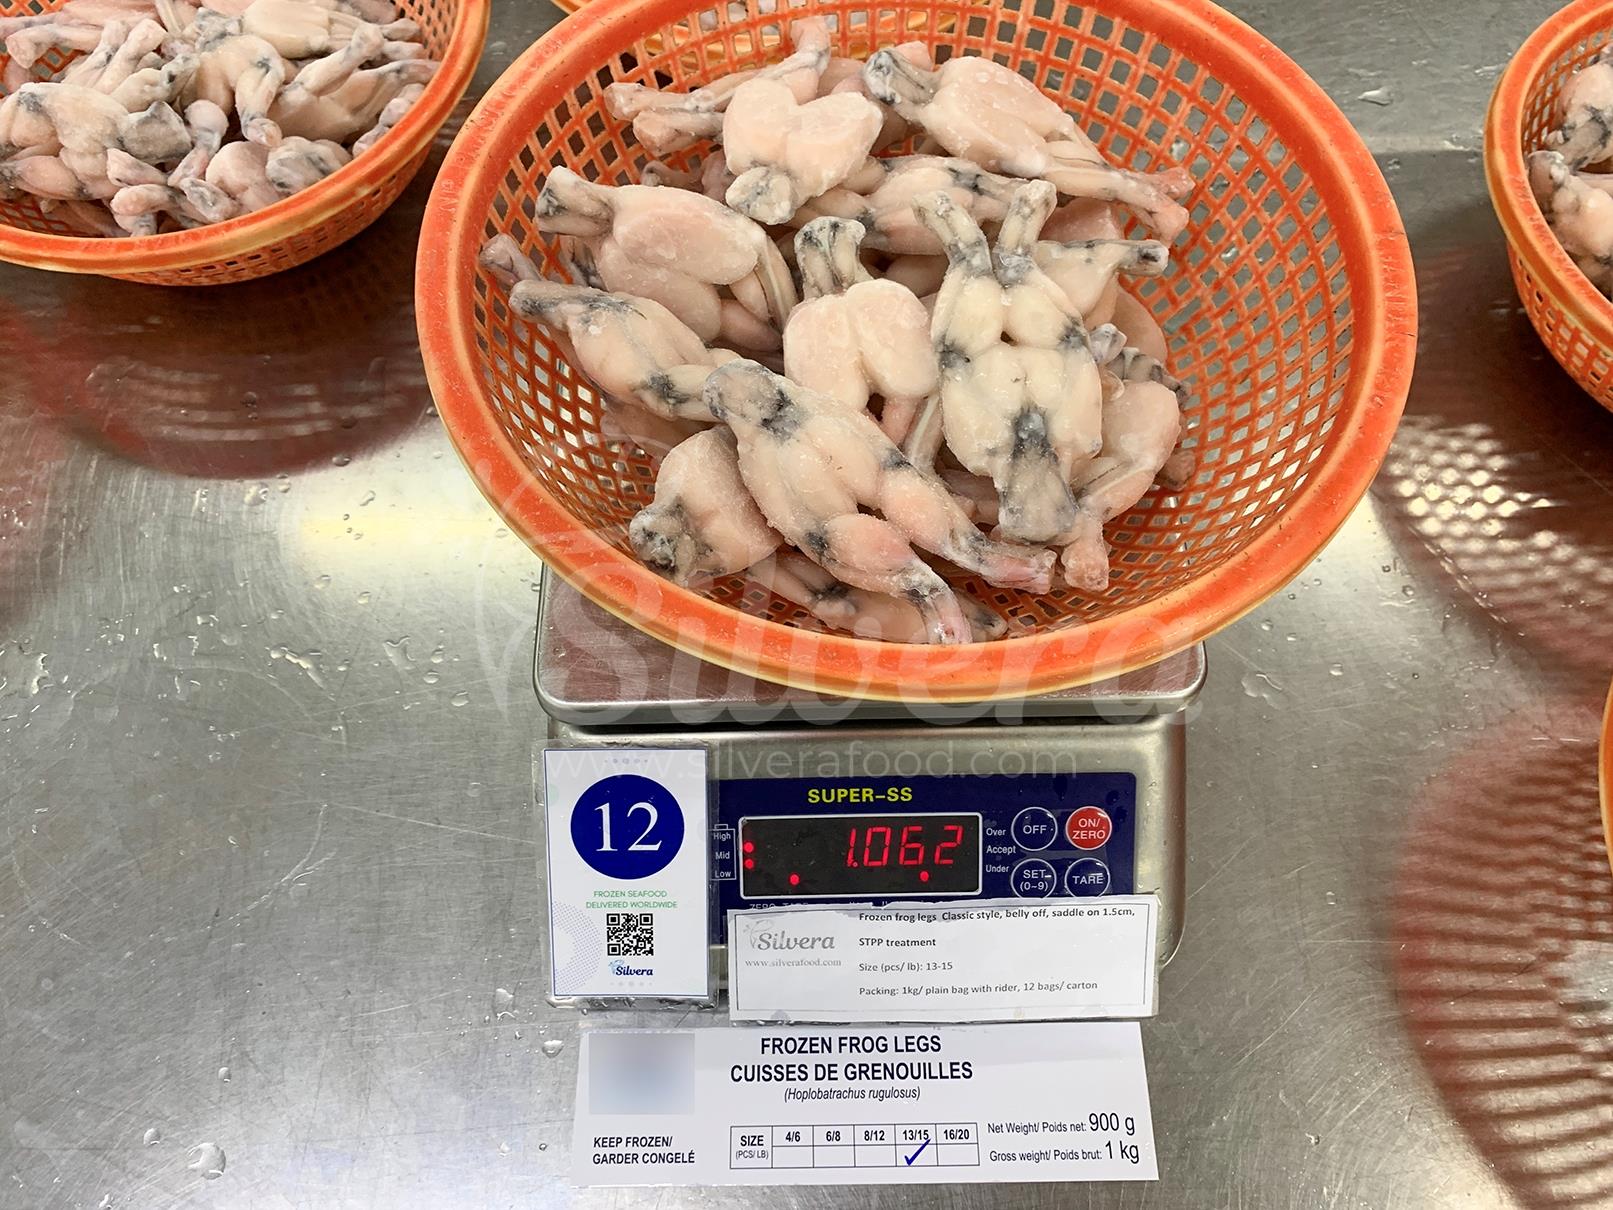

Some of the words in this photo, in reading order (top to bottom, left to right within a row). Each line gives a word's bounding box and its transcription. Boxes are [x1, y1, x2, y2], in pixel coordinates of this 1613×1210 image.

[807, 787, 913, 803] SUPER-SS
[593, 801, 662, 851] 12
[1022, 824, 1047, 835] OFF
[1078, 818, 1100, 829] ON/
[713, 832, 731, 841] High
[986, 828, 1006, 836] Over
[1072, 830, 1106, 840] ZERO
[715, 851, 730, 859] Mid
[986, 845, 1016, 855] Accept
[985, 865, 1009, 873] Under
[1072, 875, 1104, 884] TARE
[593, 890, 626, 898] FROZEN
[628, 890, 668, 898] SEAFOOD
[585, 901, 628, 909] DELIVERED
[630, 900, 678, 909] WORLDWIDE
[859, 912, 893, 922] Frozen
[895, 912, 916, 924] frog
[917, 912, 937, 924] legs
[942, 911, 974, 922] Classic
[976, 908, 1003, 920] style,
[1005, 908, 1030, 920] belly
[1032, 908, 1050, 919] off,
[1051, 907, 1085, 918] saddle
[1087, 908, 1101, 917] on
[1102, 907, 1136, 918] 1.5cm,
[757, 930, 836, 951] Silvera
[859, 937, 884, 947] STPP
[886, 937, 936, 947] treatment
[745, 958, 842, 968] www.silverafood.com
[859, 962, 879, 972] Size
[880, 961, 906, 975] (pcs/
[907, 962, 924, 973] lb):
[926, 962, 954, 972] 13-15
[615, 965, 654, 976] Silvera
[859, 986, 900, 997] Packing:
[902, 985, 924, 997] 1kg/
[925, 985, 950, 997] plain
[951, 984, 970, 996] bag
[971, 983, 993, 994] with
[994, 983, 1021, 995] rider,
[1024, 982, 1036, 991] 12
[1037, 980, 1065, 993] bags/
[1066, 981, 1098, 990] carton
[760, 1038, 832, 1055] FROZEN
[837, 1036, 889, 1053] FROG
[894, 1035, 942, 1053] LEGS
[730, 1064, 809, 1083] CUISSES
[814, 1064, 839, 1082] DE
[843, 1061, 974, 1081] GRENOUILLES
[783, 1087, 866, 1104] (Hoplobatrachus
[867, 1086, 921, 1102] rugulosus)
[987, 1122, 1004, 1134] Net
[1005, 1122, 1040, 1136] Weight/
[1042, 1121, 1068, 1133] Poids
[1069, 1122, 1087, 1132] net:
[1088, 1112, 1120, 1132] 900
[1124, 1116, 1136, 1136] g
[785, 1131, 801, 1142] 4/6
[825, 1130, 841, 1142] 6/8
[863, 1130, 885, 1142] 8/12
[902, 1129, 930, 1141] 13/15
[943, 1128, 970, 1140] 16/20
[593, 1136, 623, 1148] KEEP
[625, 1136, 673, 1148] FROZEN/
[740, 1134, 765, 1147] SIZE
[592, 1152, 640, 1165] GARDER
[641, 1149, 695, 1164] CONGELÉ
[735, 1149, 757, 1160] (PCS/
[756, 1149, 769, 1160] LB)
[989, 1150, 1017, 1162] Gross
[1018, 1149, 1051, 1163] weight/
[1053, 1149, 1080, 1161] Poids
[1081, 1149, 1102, 1160] brut:
[1105, 1140, 1114, 1160] 1
[1119, 1140, 1141, 1164] kg
